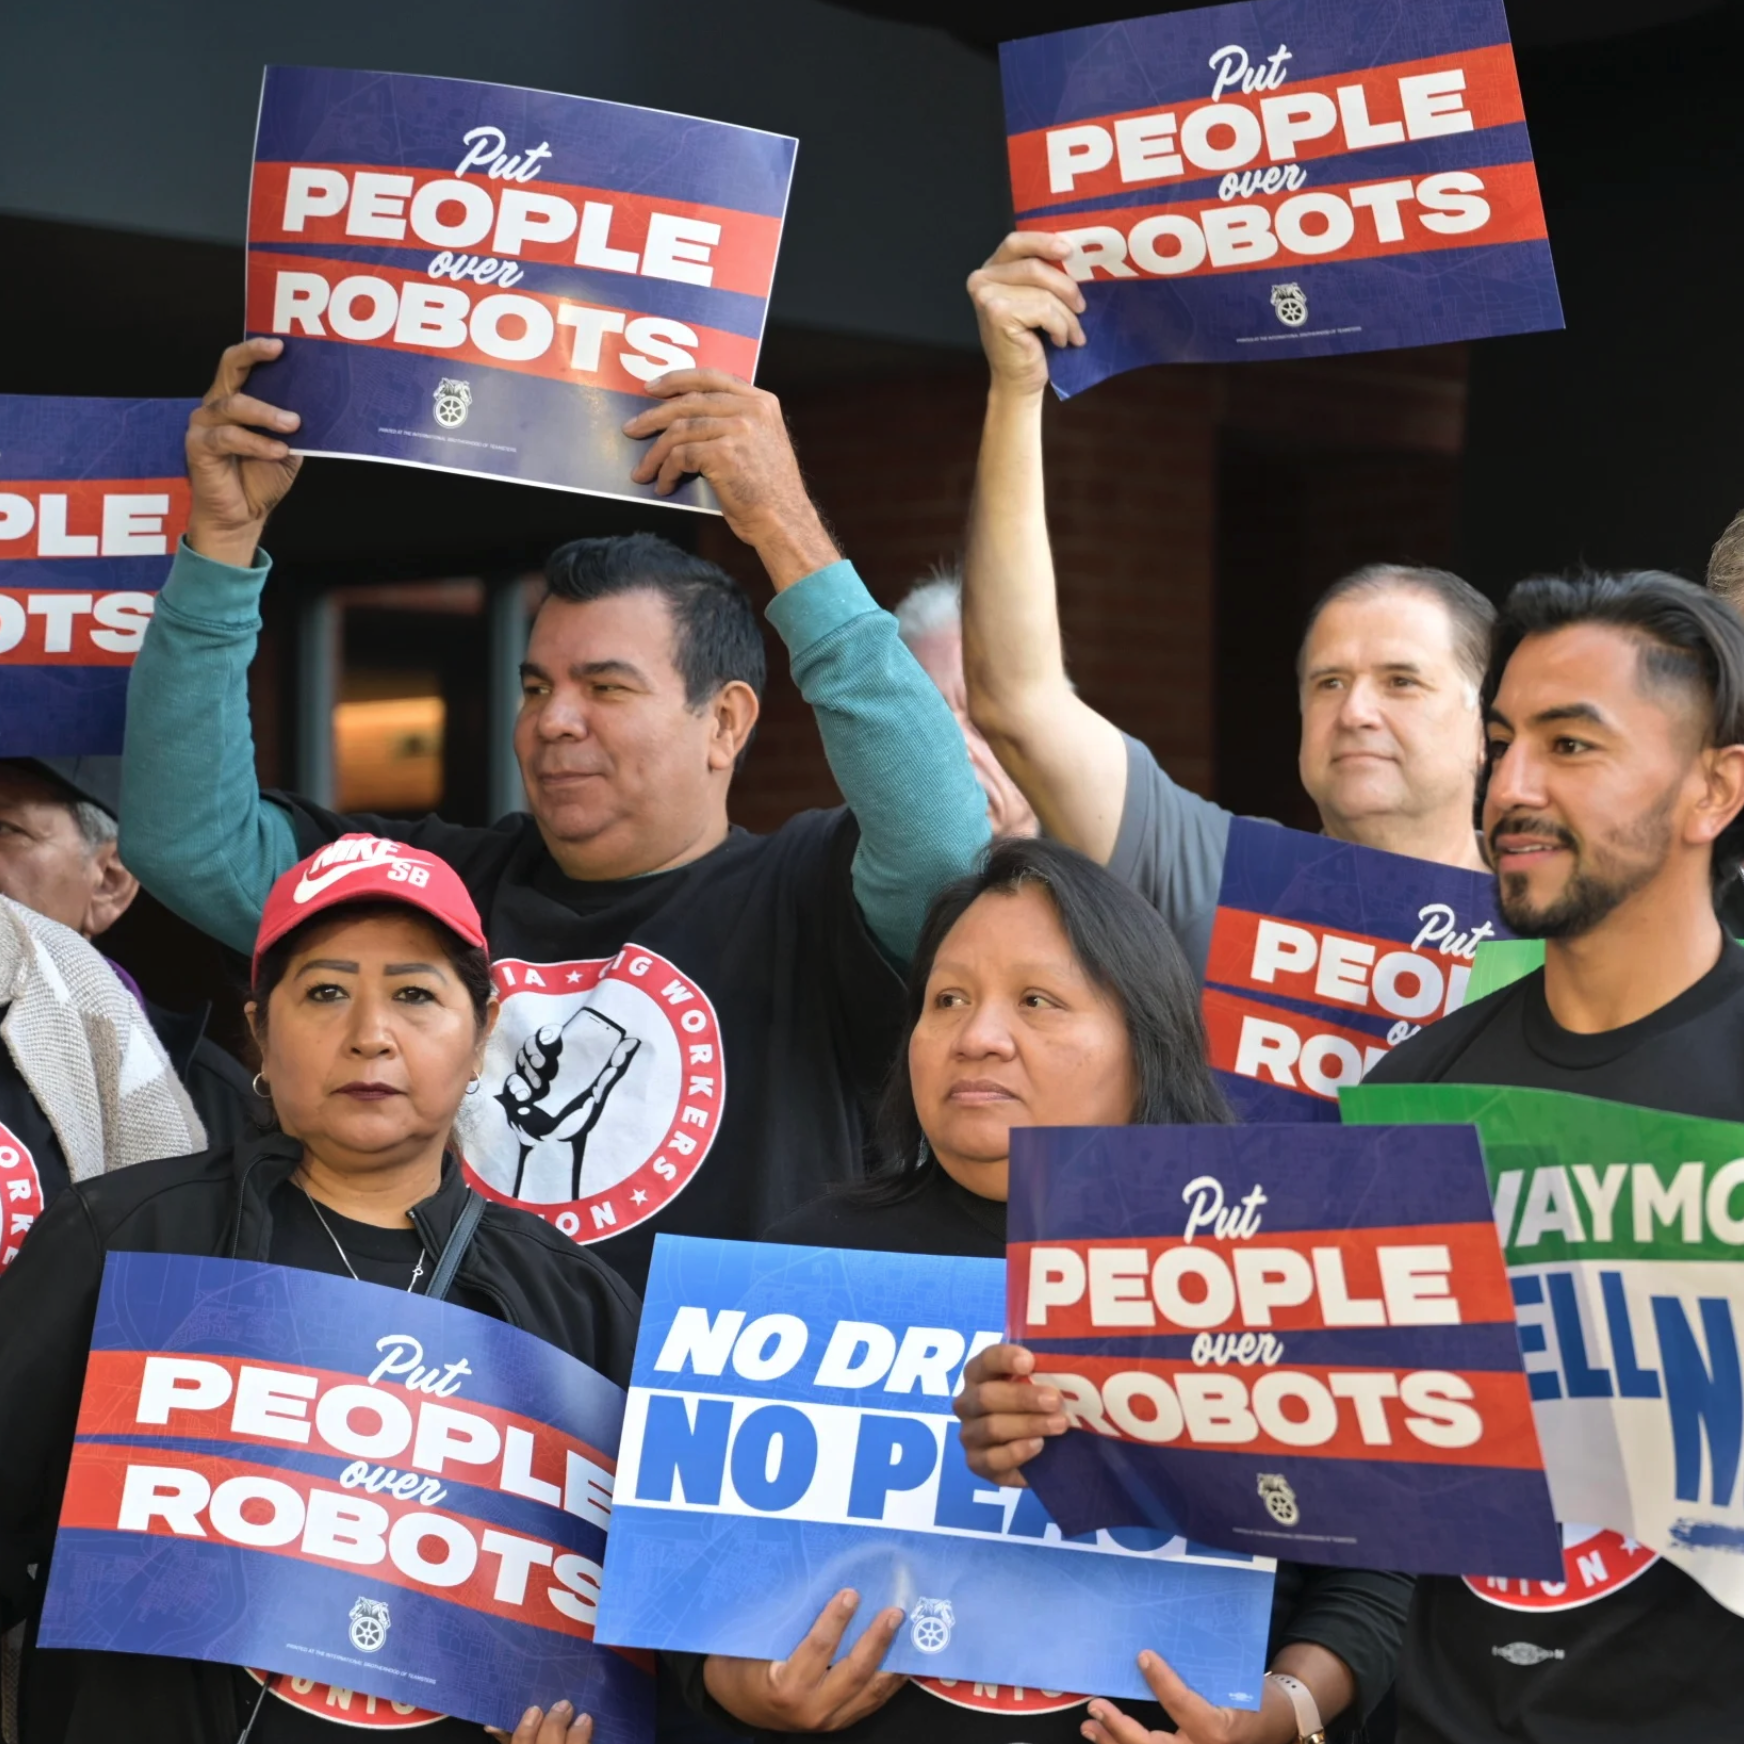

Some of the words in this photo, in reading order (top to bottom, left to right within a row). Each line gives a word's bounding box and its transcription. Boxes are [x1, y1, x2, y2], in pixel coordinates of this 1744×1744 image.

[1208, 44, 1293, 102] Put
[454, 126, 552, 182] Put
[1045, 69, 1474, 194] PEOPLE
[1218, 163, 1307, 202] over
[281, 166, 721, 288] PEOPLE
[1055, 171, 1491, 282] ROBOTS
[427, 250, 523, 289] over
[272, 270, 699, 383] ROBOTS
[309, 837, 403, 875] NIKE
[387, 860, 430, 888] SB
[1410, 903, 1495, 960] Put
[598, 950, 653, 979] IG
[653, 979, 714, 1182] WORKERS
[1234, 1015, 1389, 1098] RO
[538, 1201, 617, 1237] ON
[1182, 1176, 1268, 1244] Put
[1026, 1245, 1461, 1328] PEOPLE
[367, 1333, 472, 1398] Put
[653, 1306, 808, 1381] NO
[1190, 1330, 1284, 1367] over
[1029, 1371, 1483, 1448] ROBOTS
[1650, 1295, 1744, 1508] N
[135, 1356, 615, 1533] PEOPLE
[635, 1394, 818, 1512] NO
[339, 1459, 448, 1507] over
[117, 1464, 604, 1626] ROBOTS
